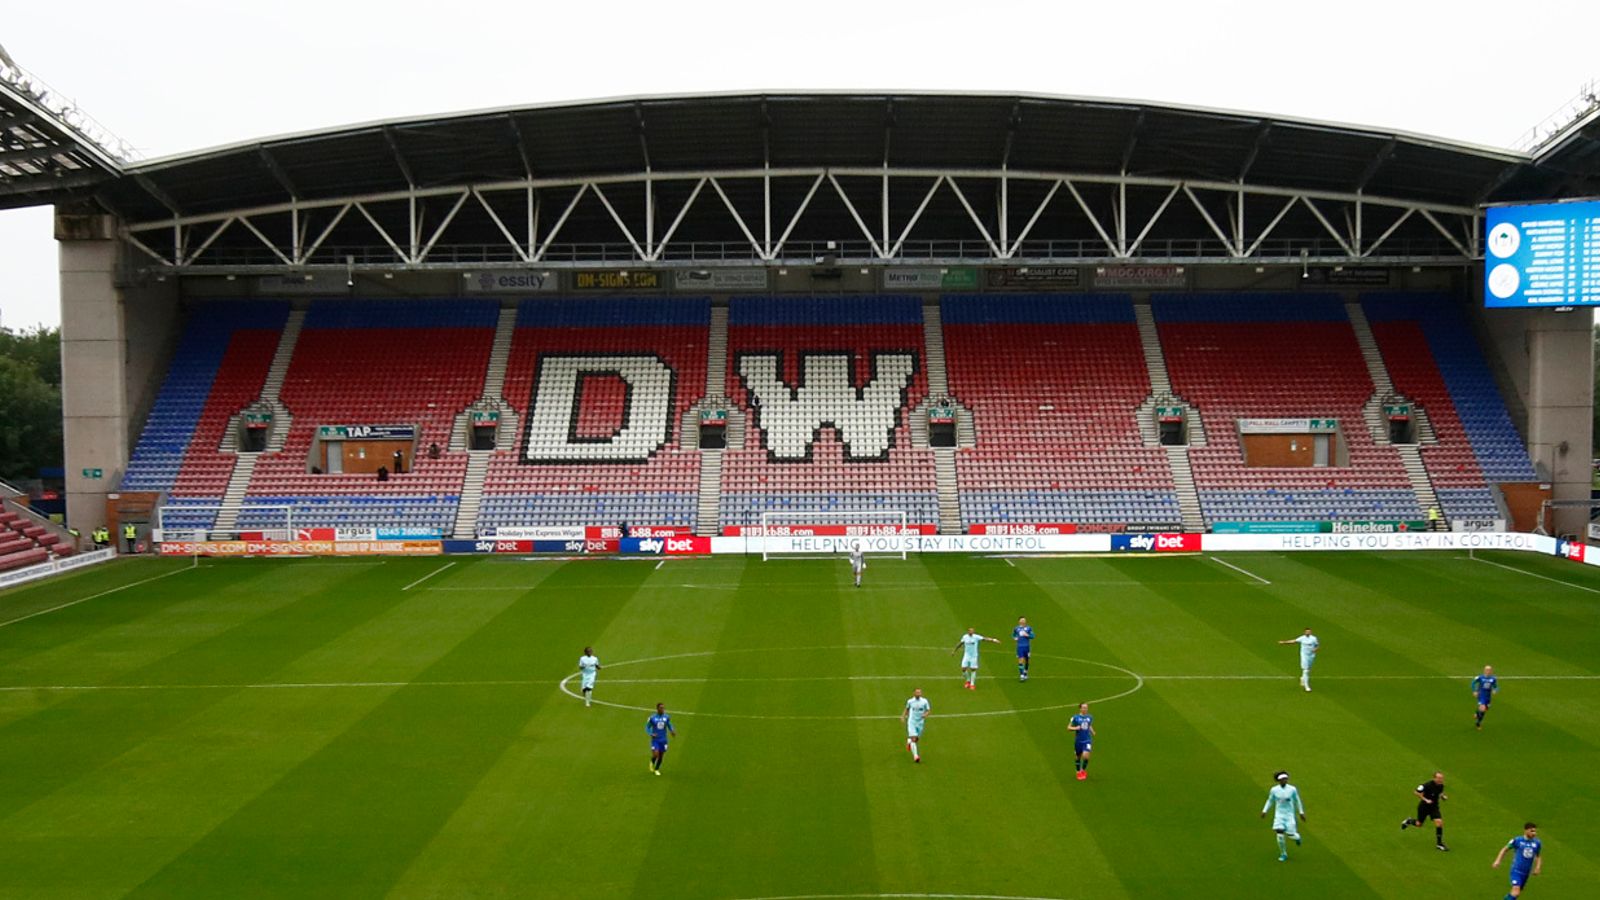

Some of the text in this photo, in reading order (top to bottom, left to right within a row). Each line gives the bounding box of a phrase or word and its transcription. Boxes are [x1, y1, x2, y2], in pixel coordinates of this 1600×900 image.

[499, 272, 545, 288] essity
[346, 426, 371, 438] TAP
[1332, 522, 1394, 533] Heineken
[1463, 519, 1494, 530] argus
[338, 528, 371, 537] argus
[475, 540, 518, 552] sky bet
[565, 540, 607, 552] sky bet
[639, 538, 693, 553] sky bet
[792, 537, 1046, 550] HELPING YOU STAY IN CONTROL
[1130, 535, 1184, 550] sky bet
[1282, 534, 1533, 548] HELPING YOU STAY IN CONTROL
